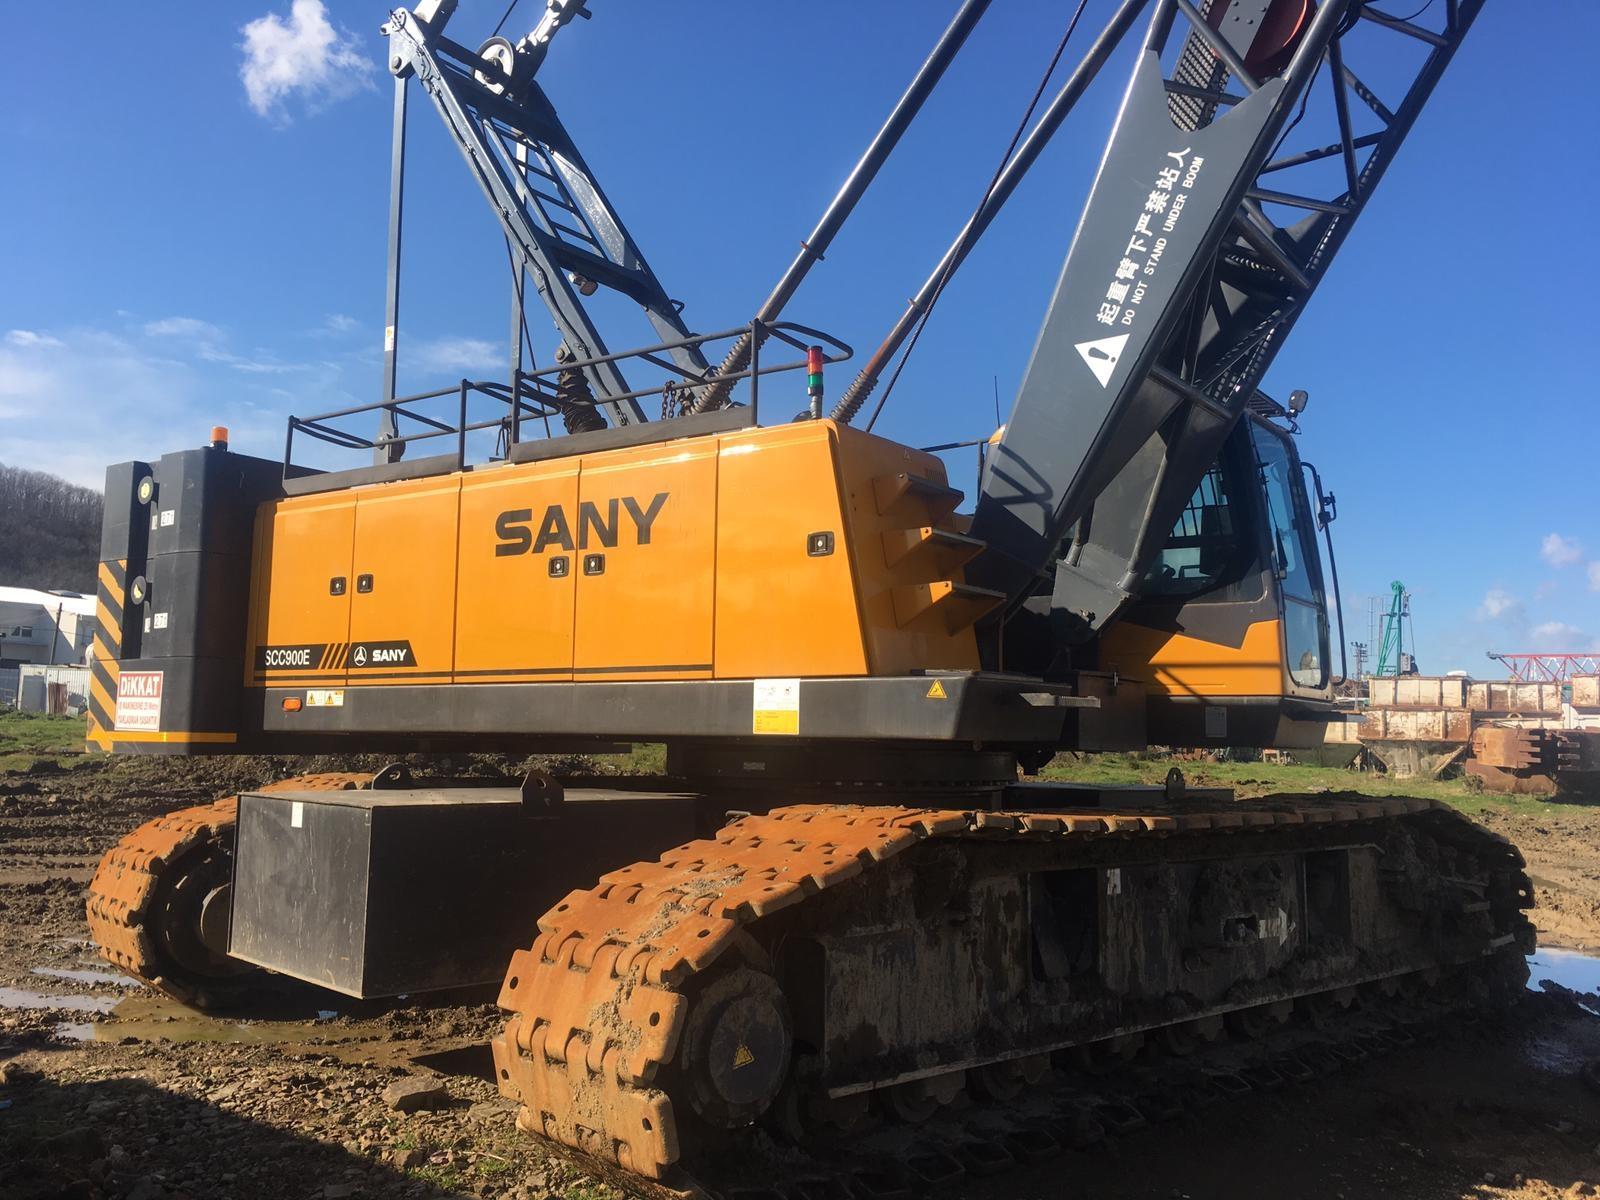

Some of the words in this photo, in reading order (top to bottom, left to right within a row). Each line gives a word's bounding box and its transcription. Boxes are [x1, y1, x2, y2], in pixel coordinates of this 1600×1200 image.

[1096, 147, 1191, 326] 起重臂下严禁站人
[1122, 309, 1136, 326] DO
[1131, 281, 1148, 305] NOT
[1143, 237, 1168, 276] STAND
[1162, 193, 1188, 232] UNDER
[1182, 156, 1204, 189] BOOM
[495, 492, 670, 557] SANY
[265, 649, 311, 666] SCC900E
[372, 649, 407, 662] SANY
